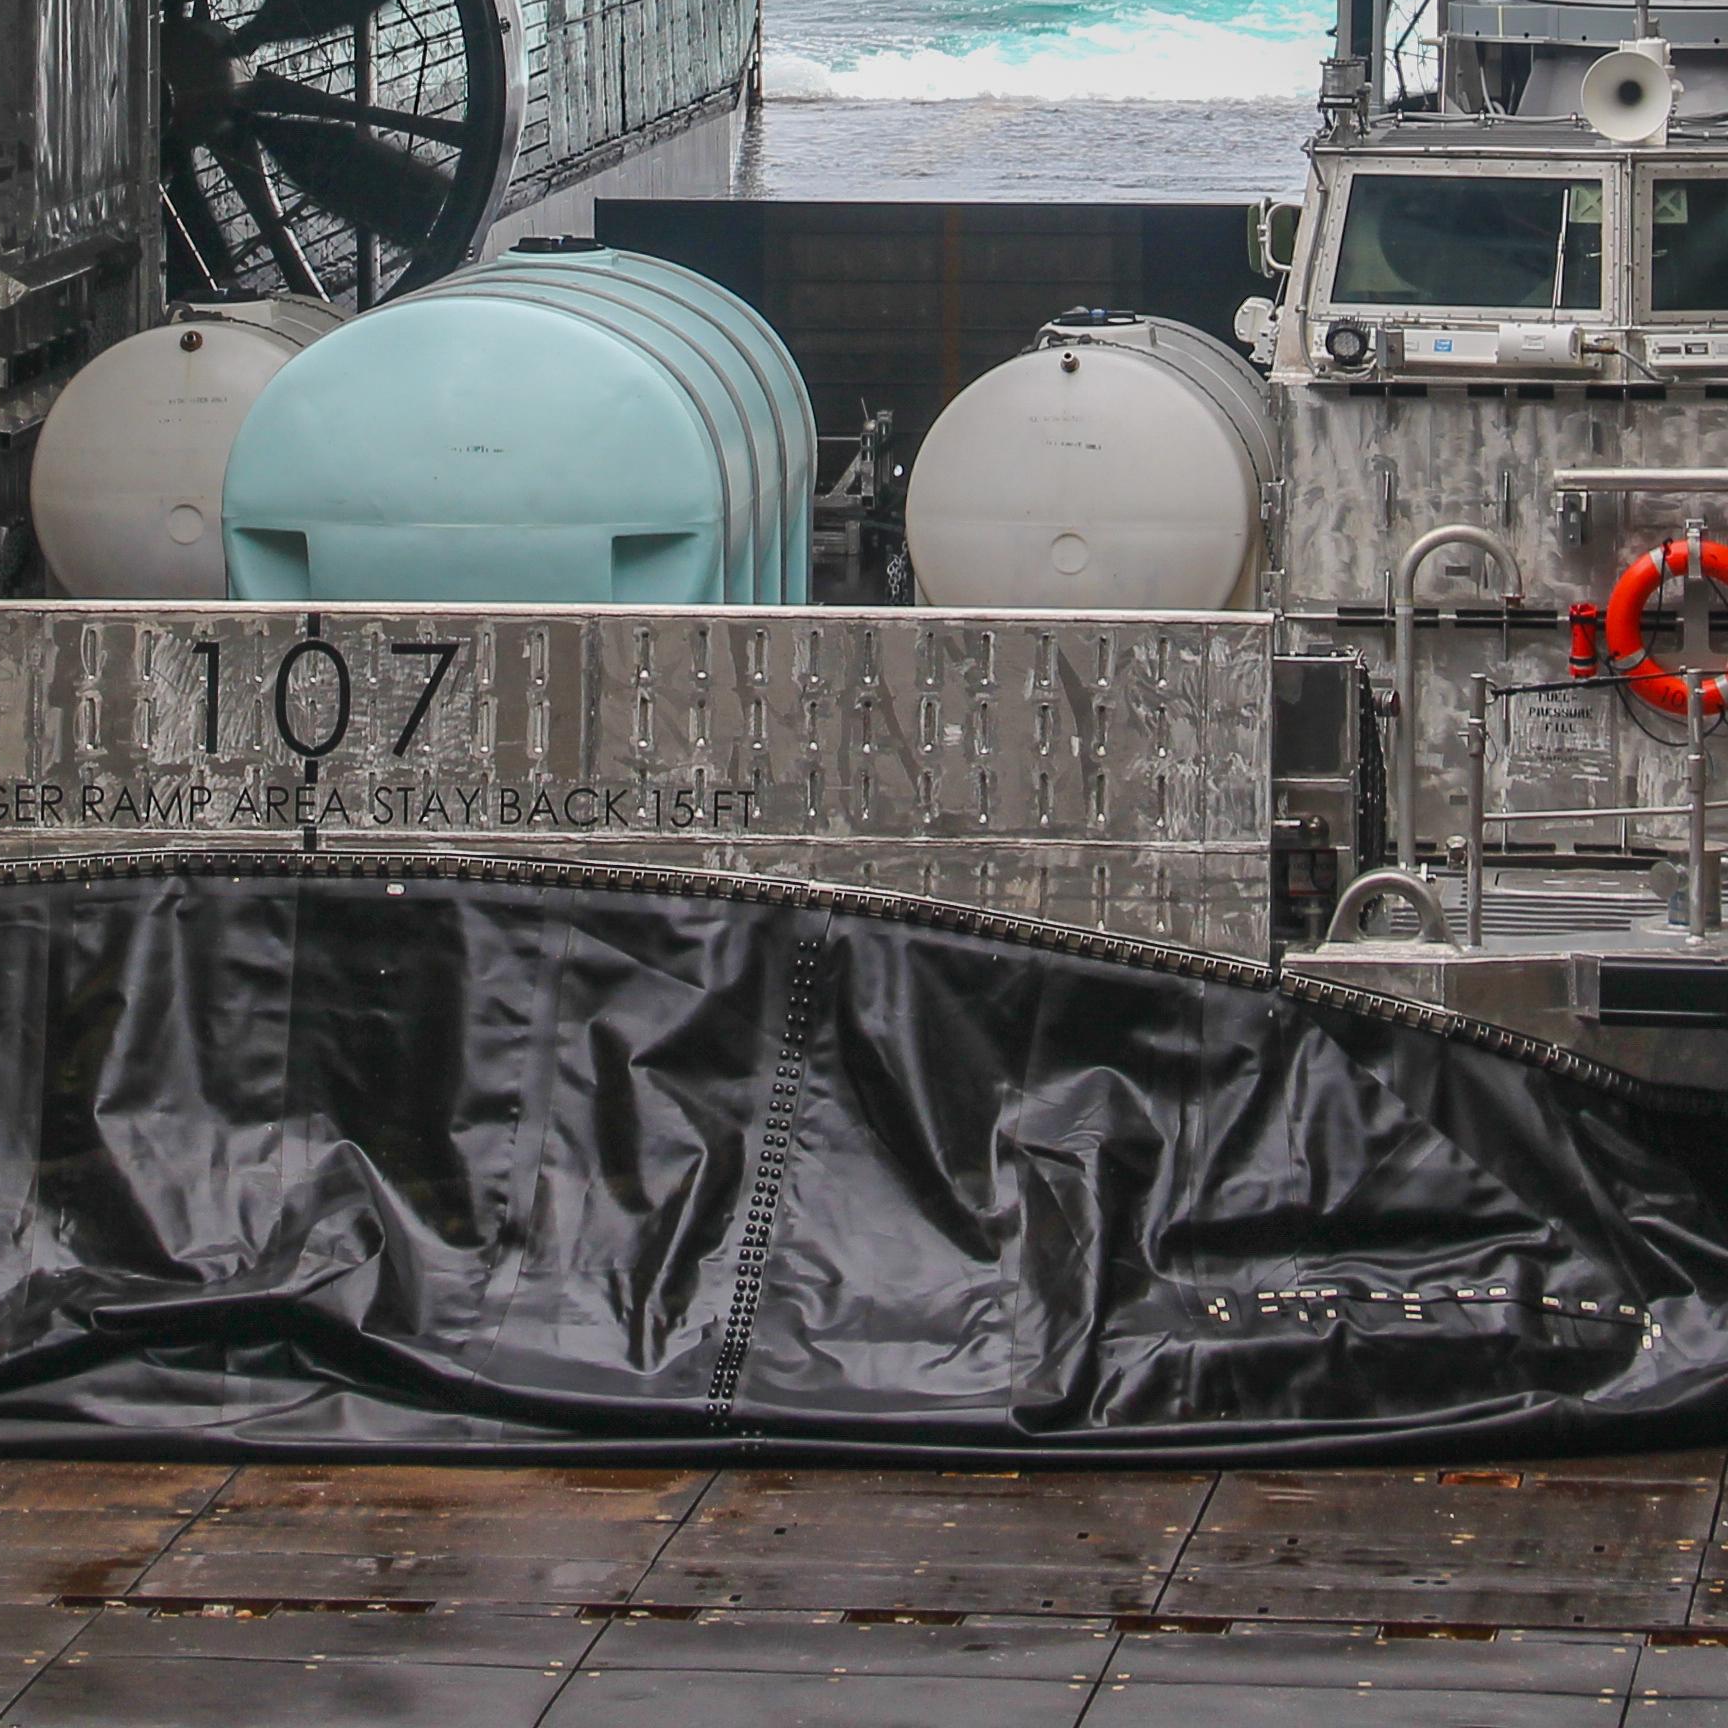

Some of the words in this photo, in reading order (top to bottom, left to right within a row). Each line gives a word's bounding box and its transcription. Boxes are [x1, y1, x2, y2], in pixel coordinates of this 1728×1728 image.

[192, 638, 460, 758] 107
[1529, 706, 1593, 720] PRESSURE
[1545, 722, 1577, 734] FILL
[81, 785, 213, 823] RAMP
[229, 786, 351, 825] AREA
[372, 787, 475, 826] STAY
[499, 788, 629, 827] BACK
[651, 789, 695, 829] 15
[712, 790, 756, 829] FT
